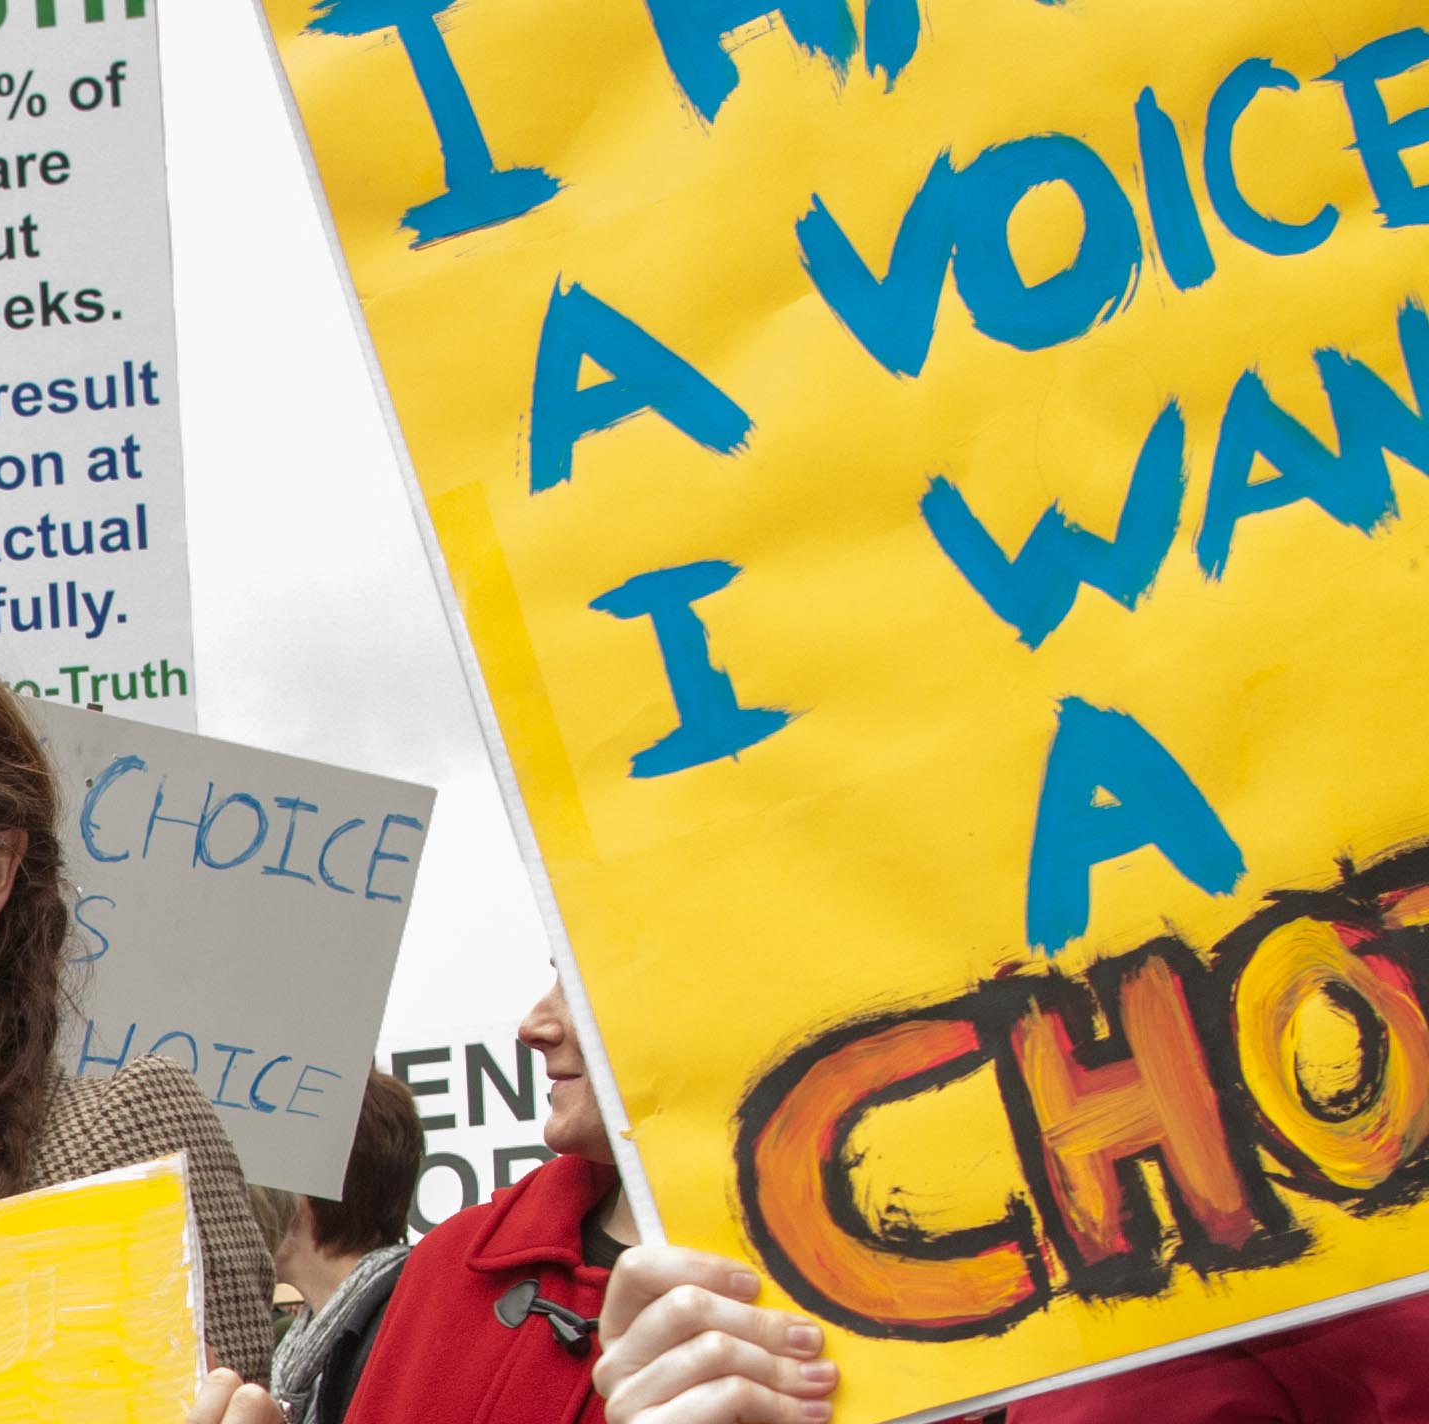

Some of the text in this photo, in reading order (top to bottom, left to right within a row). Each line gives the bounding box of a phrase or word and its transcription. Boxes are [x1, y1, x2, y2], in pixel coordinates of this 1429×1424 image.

[68, 61, 128, 113] of
[515, 270, 759, 498] A
[791, 25, 1429, 381] VOICE
[85, 433, 143, 485] at
[587, 558, 813, 780] I
[80, 754, 425, 904] CHOICE
[1025, 694, 1248, 960] A
[729, 835, 1429, 1342] CHO
